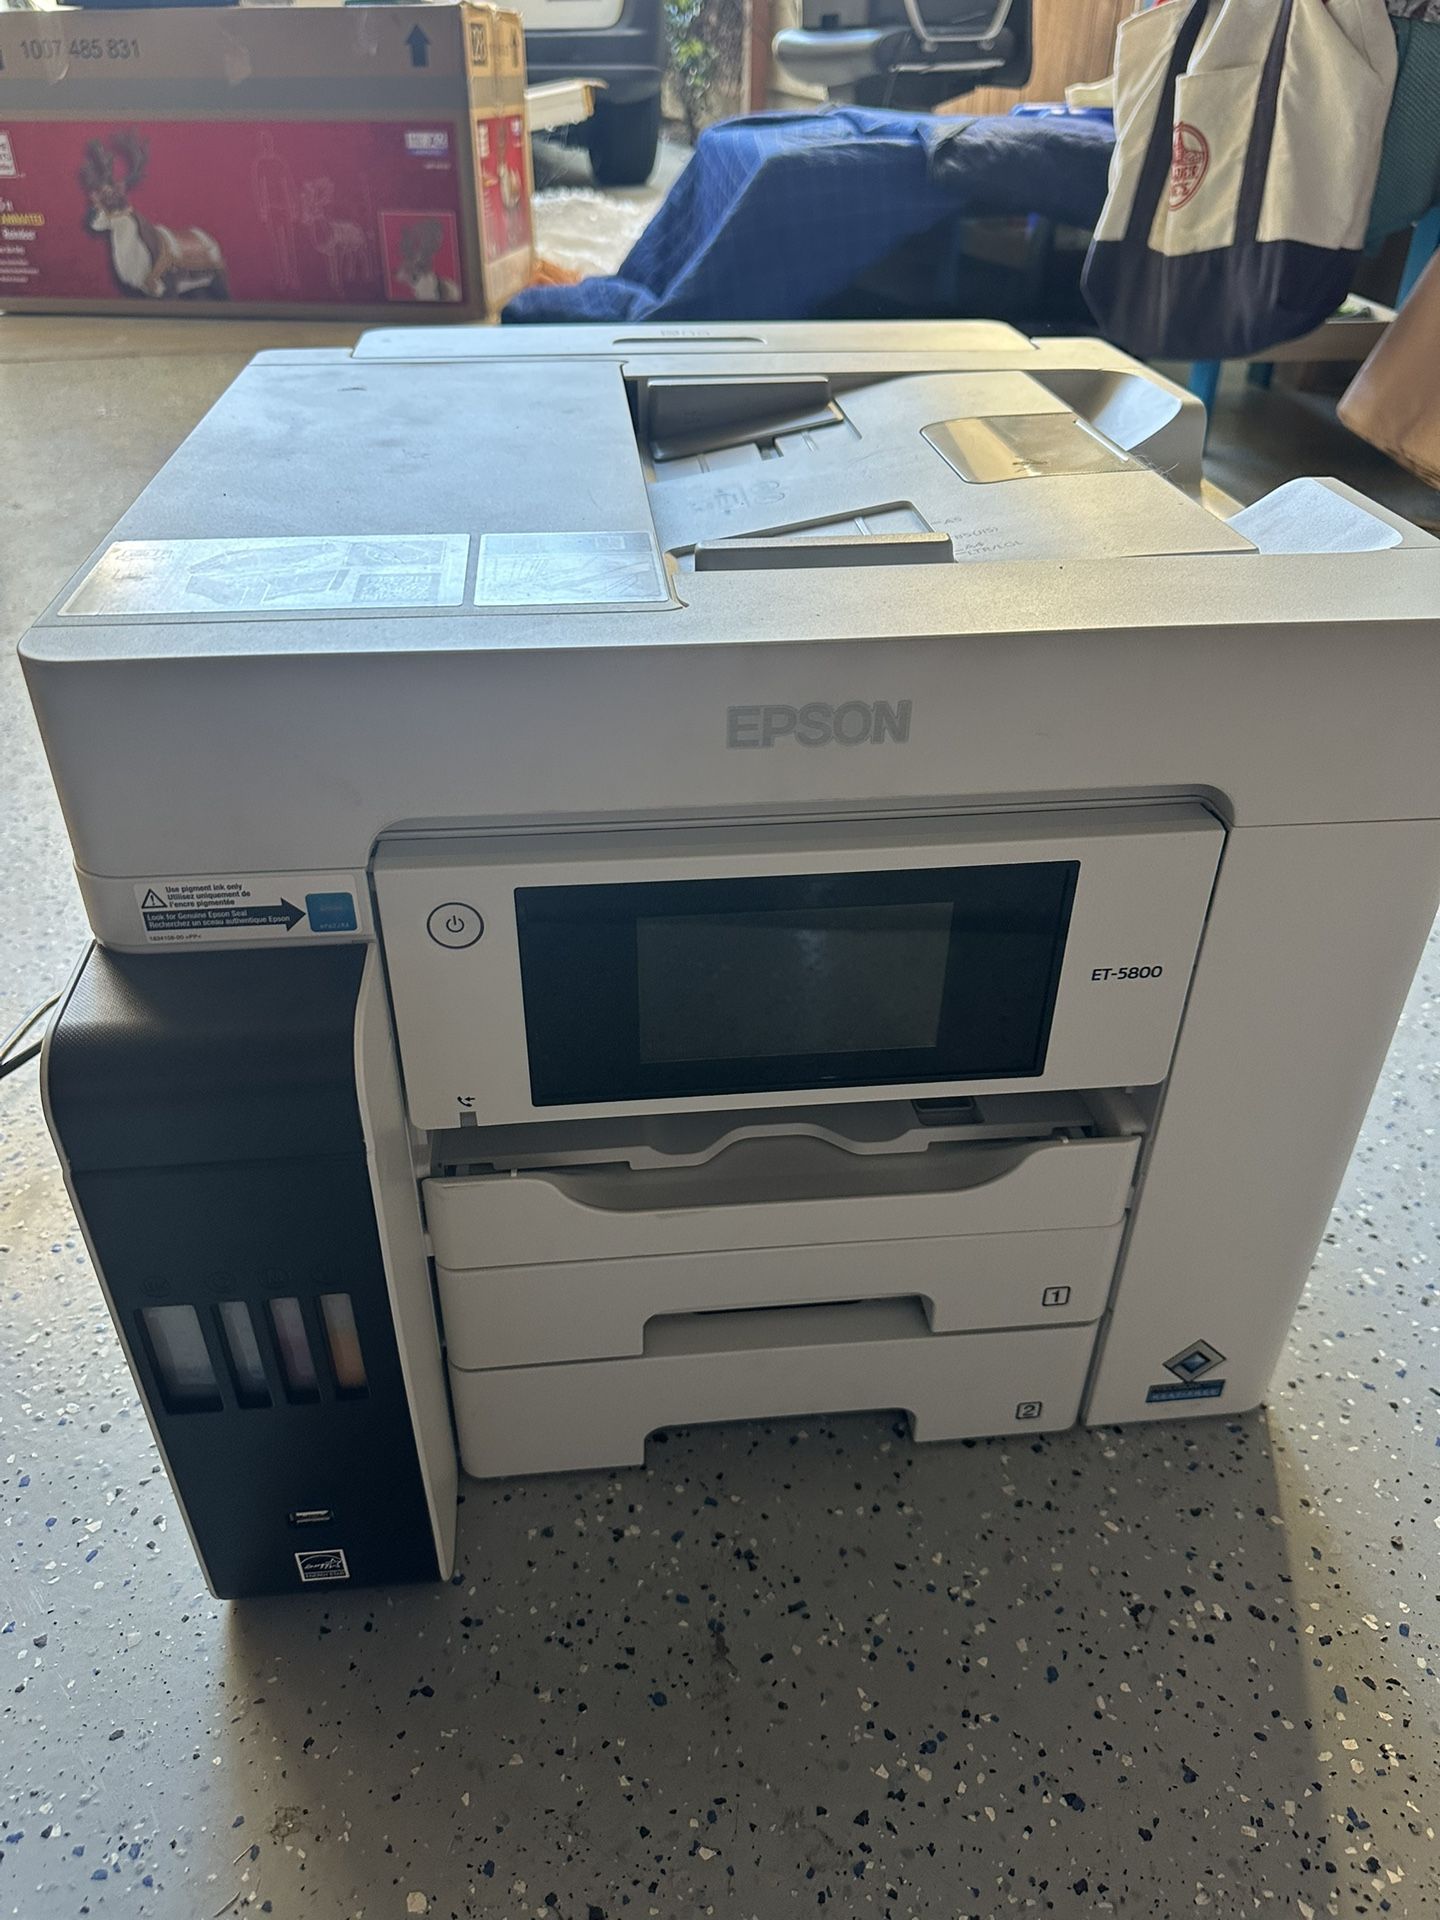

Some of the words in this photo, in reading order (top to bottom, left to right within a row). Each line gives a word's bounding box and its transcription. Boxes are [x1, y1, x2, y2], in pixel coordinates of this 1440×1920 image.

[20, 38, 62, 60] 1007
[69, 37, 103, 60] 485
[107, 37, 141, 60] 831
[727, 700, 912, 748] EPSON
[181, 884, 212, 894] pigment
[213, 883, 225, 891] ink
[226, 882, 243, 891] only
[167, 892, 195, 900] Utilisez
[196, 891, 240, 900] uniquement
[147, 913, 164, 922] Look
[166, 912, 177, 920] for
[178, 911, 207, 920] Genuine
[208, 910, 231, 920] Epson
[232, 910, 248, 918] Seal
[149, 919, 190, 928] Recherchez
[203, 918, 224, 926] sceau
[225, 917, 268, 926] authentique
[268, 914, 291, 924] Epson
[1091, 965, 1164, 982] ET-5800
[1051, 1289, 1060, 1303] 1
[1022, 1403, 1036, 1417] 2
